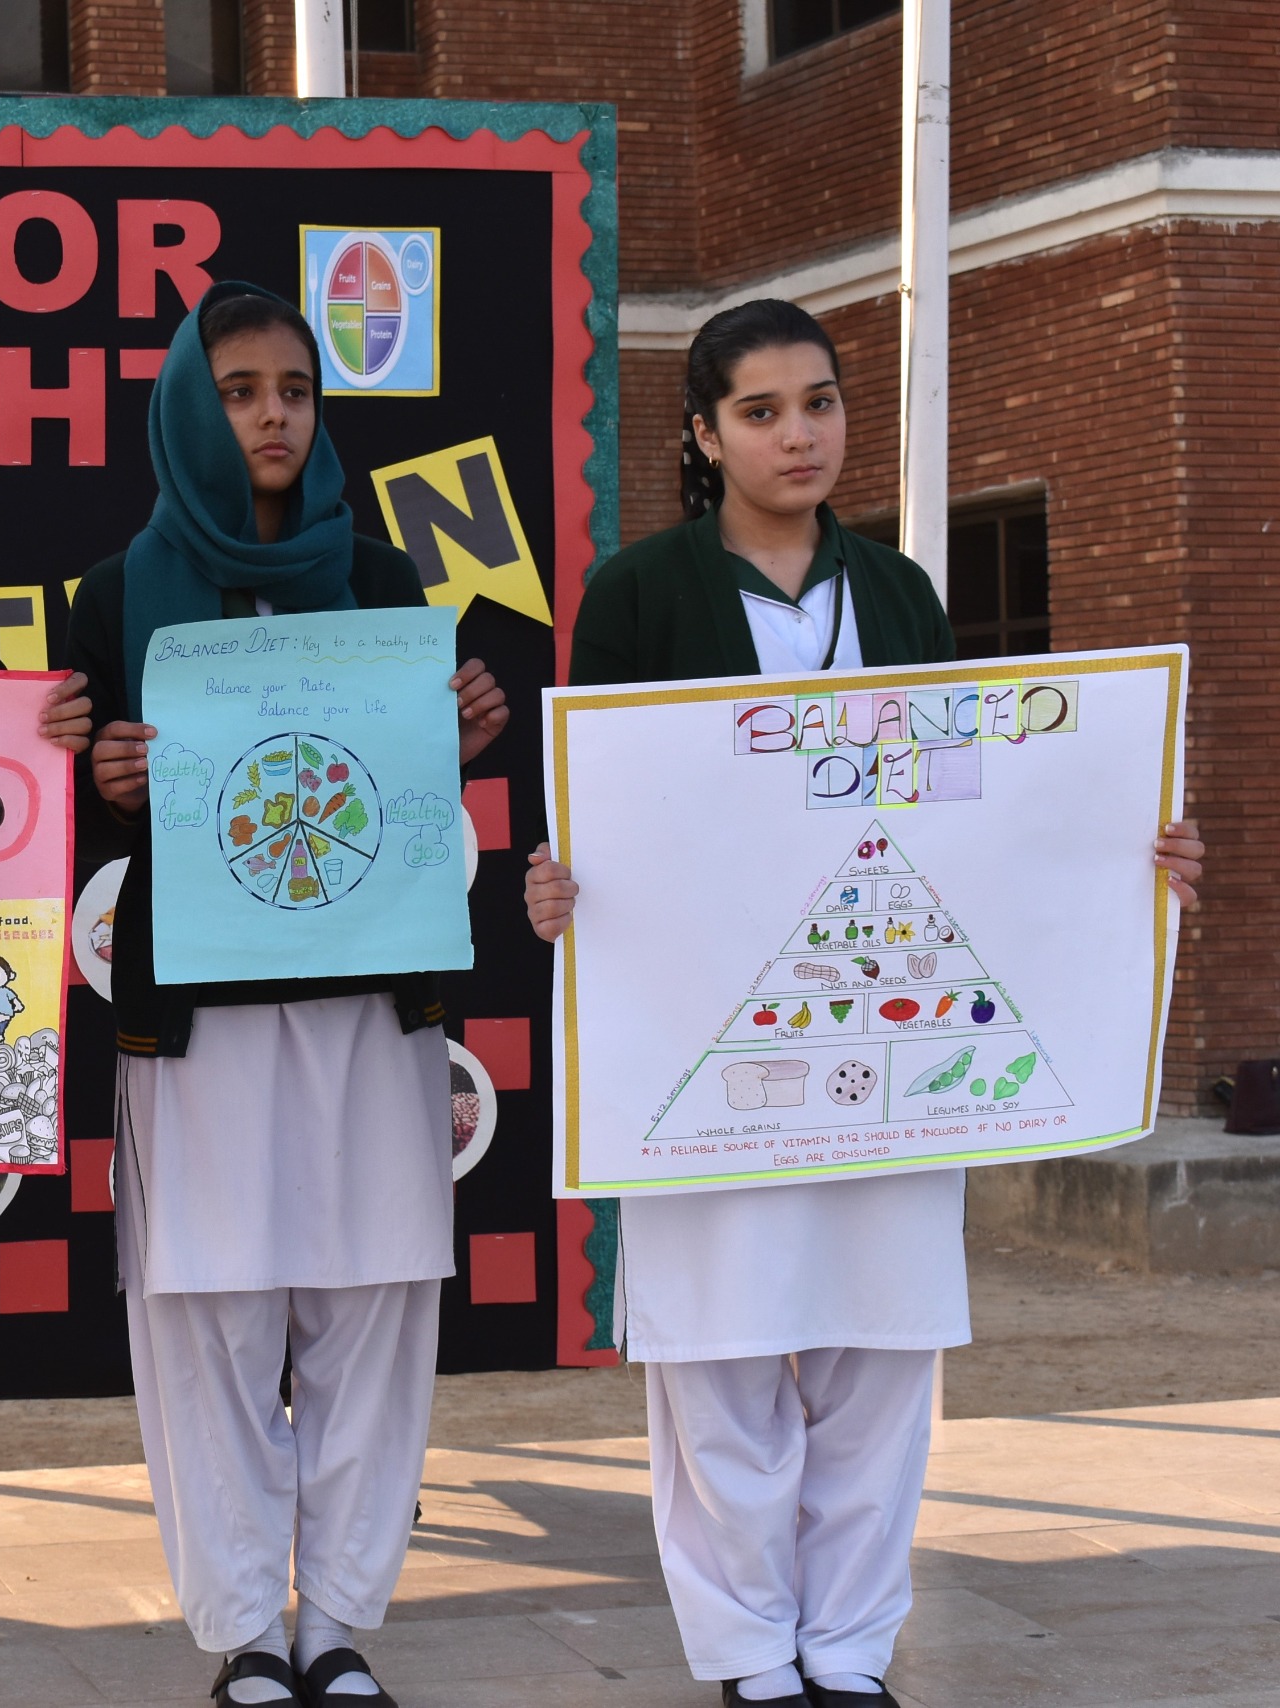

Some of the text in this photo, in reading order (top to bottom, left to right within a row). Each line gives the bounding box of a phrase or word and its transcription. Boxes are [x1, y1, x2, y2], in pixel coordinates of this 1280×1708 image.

[407, 259, 423, 271] Dairy
[338, 273, 357, 283] Fruits
[371, 281, 391, 290] Grains
[331, 319, 362, 331] Vegetables
[370, 329, 392, 339] Protein
[155, 636, 239, 661] BALANCED
[303, 635, 320, 657] Key
[333, 635, 345, 647] to
[357, 639, 366, 647] a
[419, 635, 438, 646] life
[205, 677, 252, 695] Balance
[262, 683, 287, 698] your
[257, 701, 387, 721] Balance your life
[736, 685, 1069, 754] BALANCED
[153, 760, 210, 786] Healthy
[812, 738, 973, 803] DIET
[165, 800, 202, 822] food
[388, 804, 450, 829] Healthy
[848, 865, 889, 876] SWEETS
[826, 903, 855, 912] DAIRY
[888, 900, 913, 910] EGGS
[812, 939, 881, 951] VEGETABLE OILS
[754, 960, 772, 986] servings
[821, 976, 907, 990] NUTS AND SEEDS
[894, 1018, 951, 1030] VEGETABLES
[774, 1028, 804, 1038] FRUITS
[667, 1069, 691, 1101] servings
[927, 1101, 1020, 1116] LEGUMES AND SOY
[653, 1146, 662, 1156] A
[670, 1144, 718, 1156] RELIABLE
[723, 1141, 759, 1152] SOURCE
[764, 1139, 776, 1149] OF
[782, 1135, 831, 1148] VITAMIN
[864, 1130, 900, 1142] SHOULD
[904, 1128, 916, 1139] BE
[921, 1124, 969, 1138] INCLUDED
[995, 1121, 1012, 1132] NO
[1019, 1117, 1047, 1130] DAIRY
[1054, 1115, 1067, 1126] OR
[697, 1122, 781, 1137] WHOLE GRAINS
[773, 1146, 891, 1166] EGGS ARE CONSUMED
